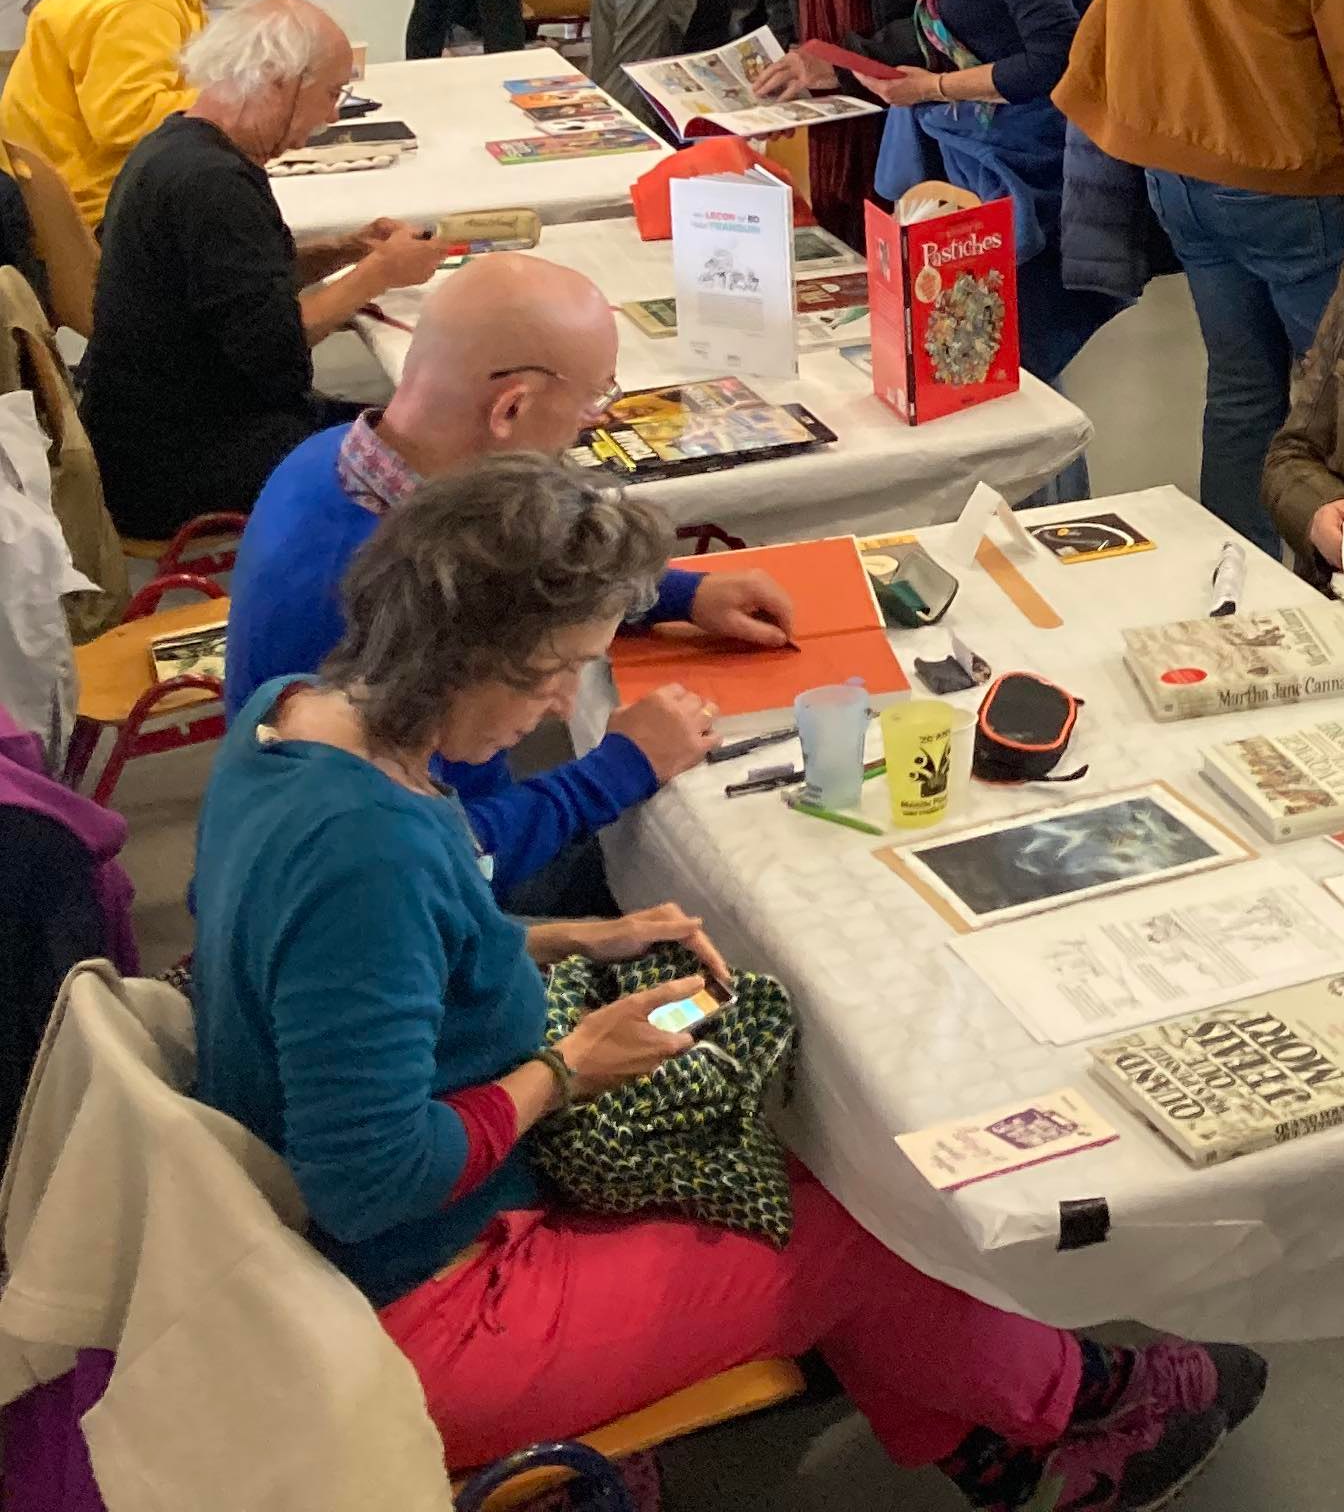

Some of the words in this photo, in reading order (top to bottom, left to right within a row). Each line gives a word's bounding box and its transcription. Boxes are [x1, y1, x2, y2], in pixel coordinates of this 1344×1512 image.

[921, 231, 1002, 268] Pastiches
[1218, 684, 1269, 707] Martha
[1272, 681, 1301, 700] Jane
[1114, 1050, 1206, 1121] QUAND
